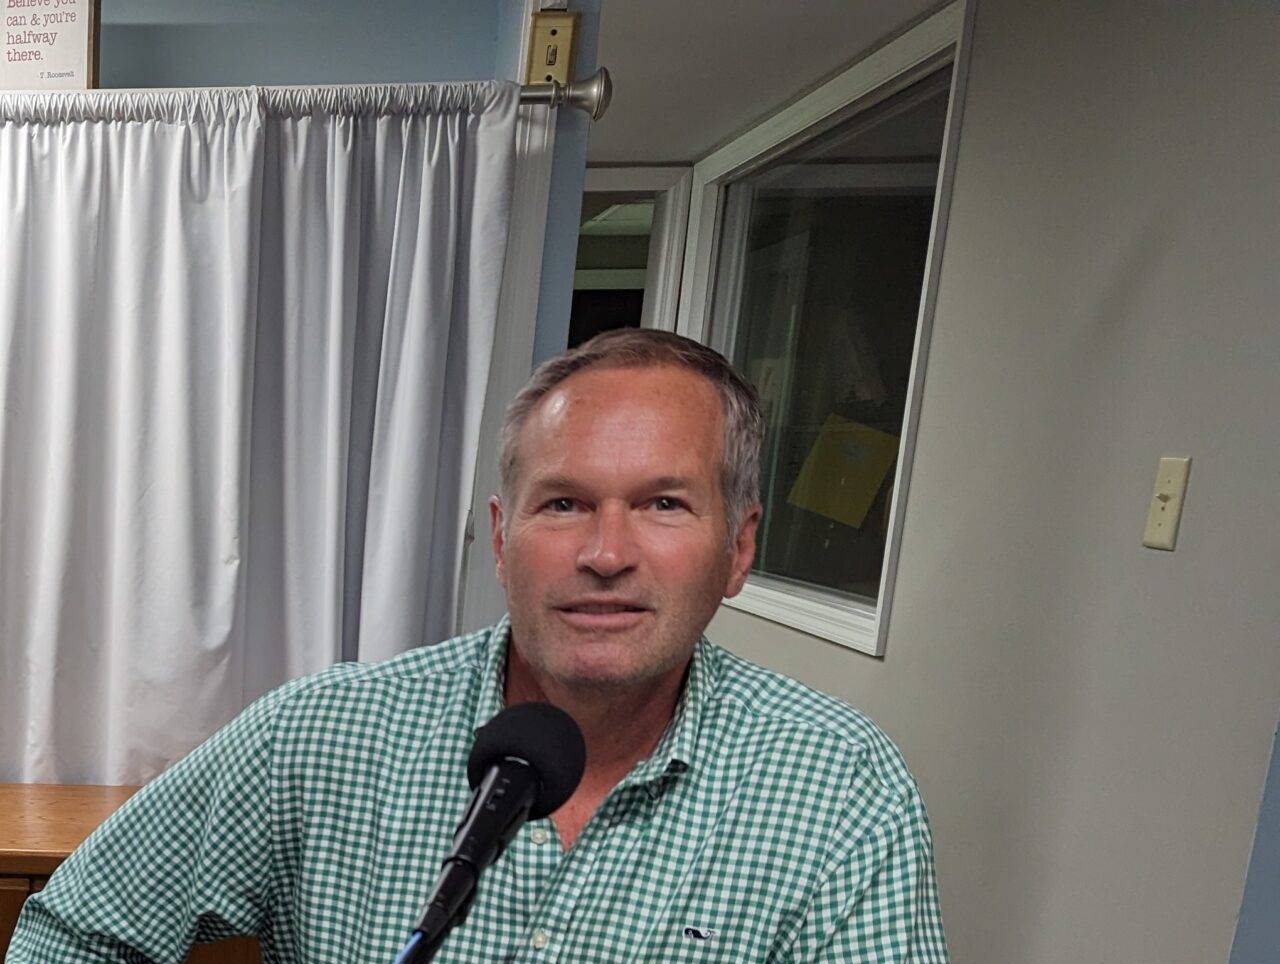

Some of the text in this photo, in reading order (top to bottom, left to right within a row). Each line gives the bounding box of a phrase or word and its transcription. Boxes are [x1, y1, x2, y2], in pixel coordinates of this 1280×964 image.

[6, 11, 77, 27] can & you're
[6, 31, 58, 45] halfway
[6, 49, 44, 62] there.
